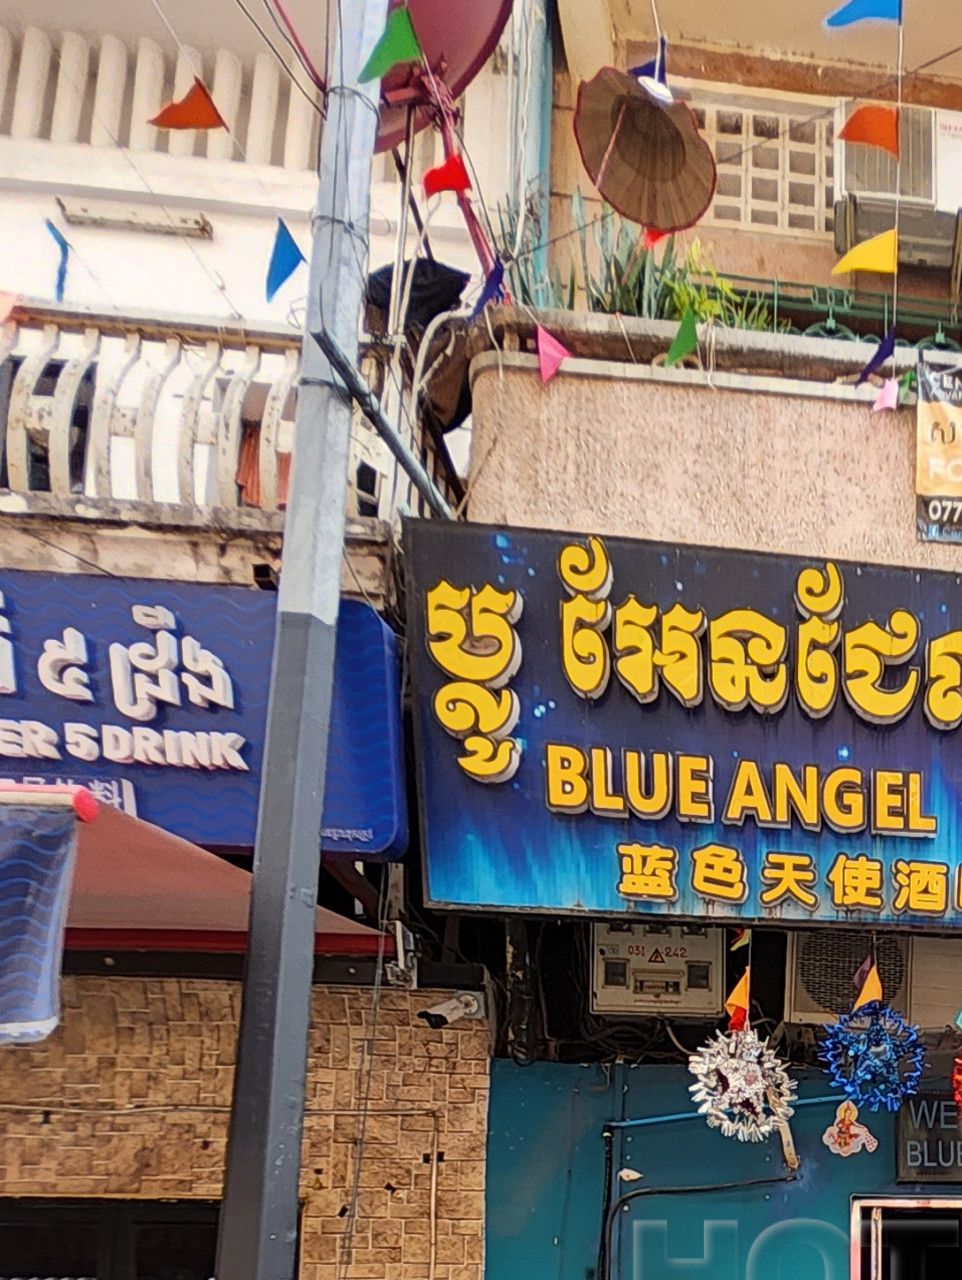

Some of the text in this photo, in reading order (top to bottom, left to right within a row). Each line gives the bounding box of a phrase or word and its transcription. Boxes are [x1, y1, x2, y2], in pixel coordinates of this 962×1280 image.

[927, 499, 962, 522] 077
[102, 724, 250, 771] DRINK
[545, 742, 938, 833] BLUE ANGEL
[628, 945, 645, 957] 031
